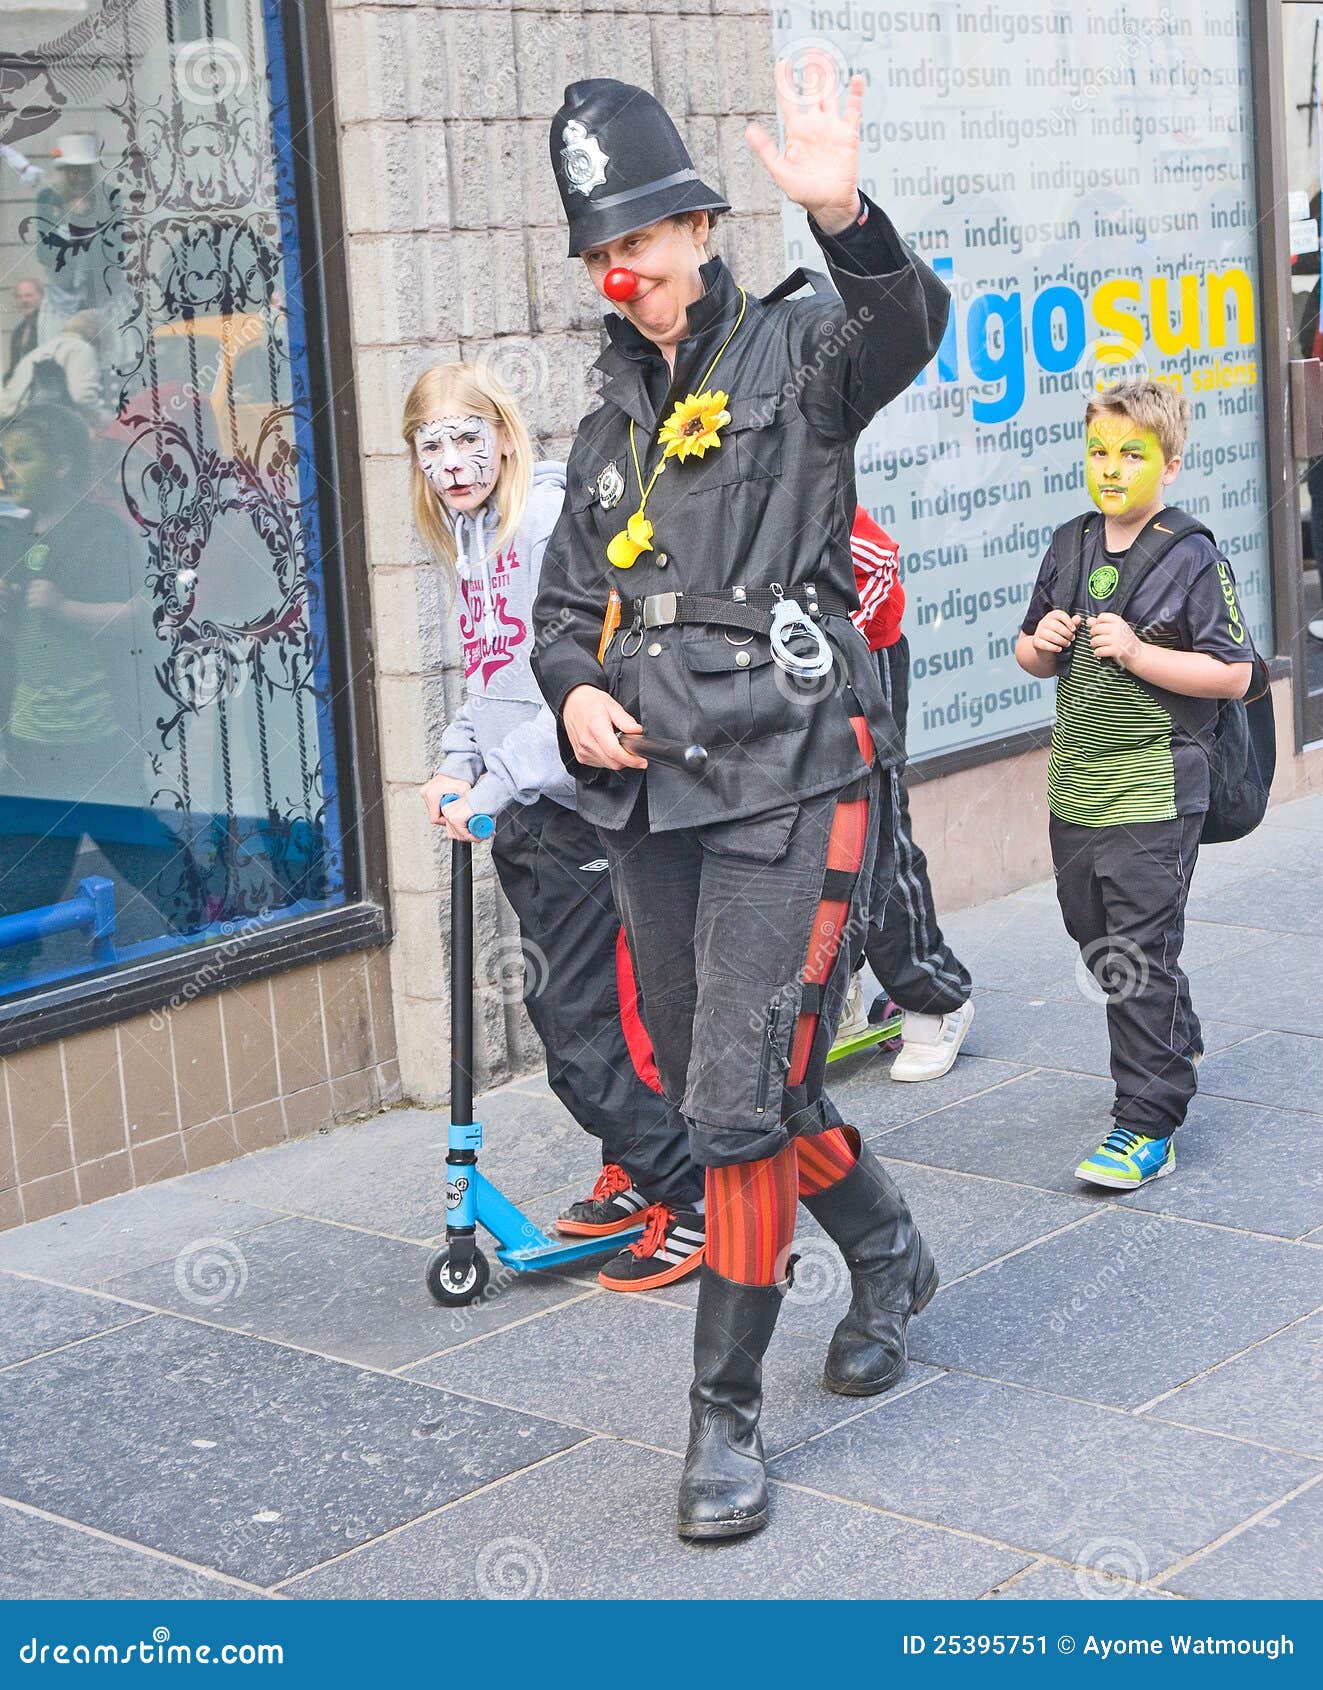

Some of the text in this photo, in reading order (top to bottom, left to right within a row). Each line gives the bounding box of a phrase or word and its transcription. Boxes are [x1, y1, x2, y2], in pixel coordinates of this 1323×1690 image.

[810, 7, 942, 42] indigosun
[956, 4, 1073, 44] indigosun
[888, 57, 1012, 98] indigosun
[960, 110, 1077, 149] indigosun
[1090, 105, 1197, 145] indigosun
[893, 163, 1016, 205] indigosun
[1029, 160, 1141, 198] indigosun
[964, 216, 1081, 254] indigosun
[1094, 208, 1199, 244] indigosun
[1191, 358, 1259, 394] salons
[910, 477, 1032, 522] indigosun
[922, 681, 1043, 731] indigosun
